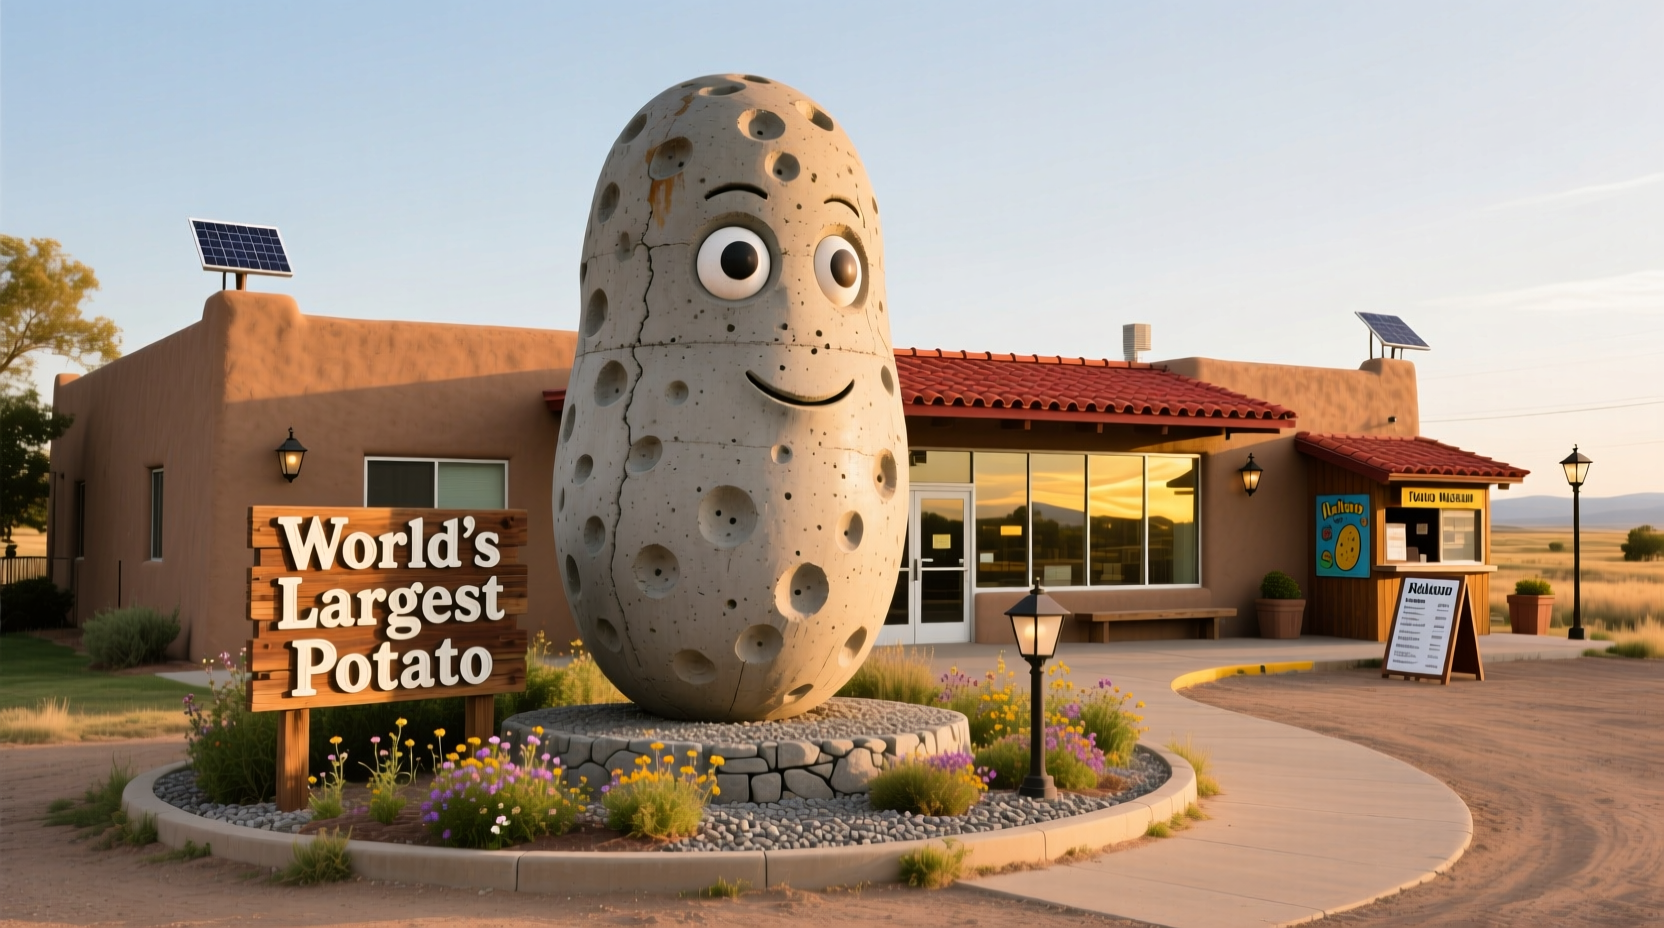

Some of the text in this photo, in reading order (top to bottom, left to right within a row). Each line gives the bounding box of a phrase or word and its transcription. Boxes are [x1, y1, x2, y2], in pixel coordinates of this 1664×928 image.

[277, 515, 501, 571] World's
[277, 575, 505, 640] Largest
[291, 638, 493, 697] Potato
